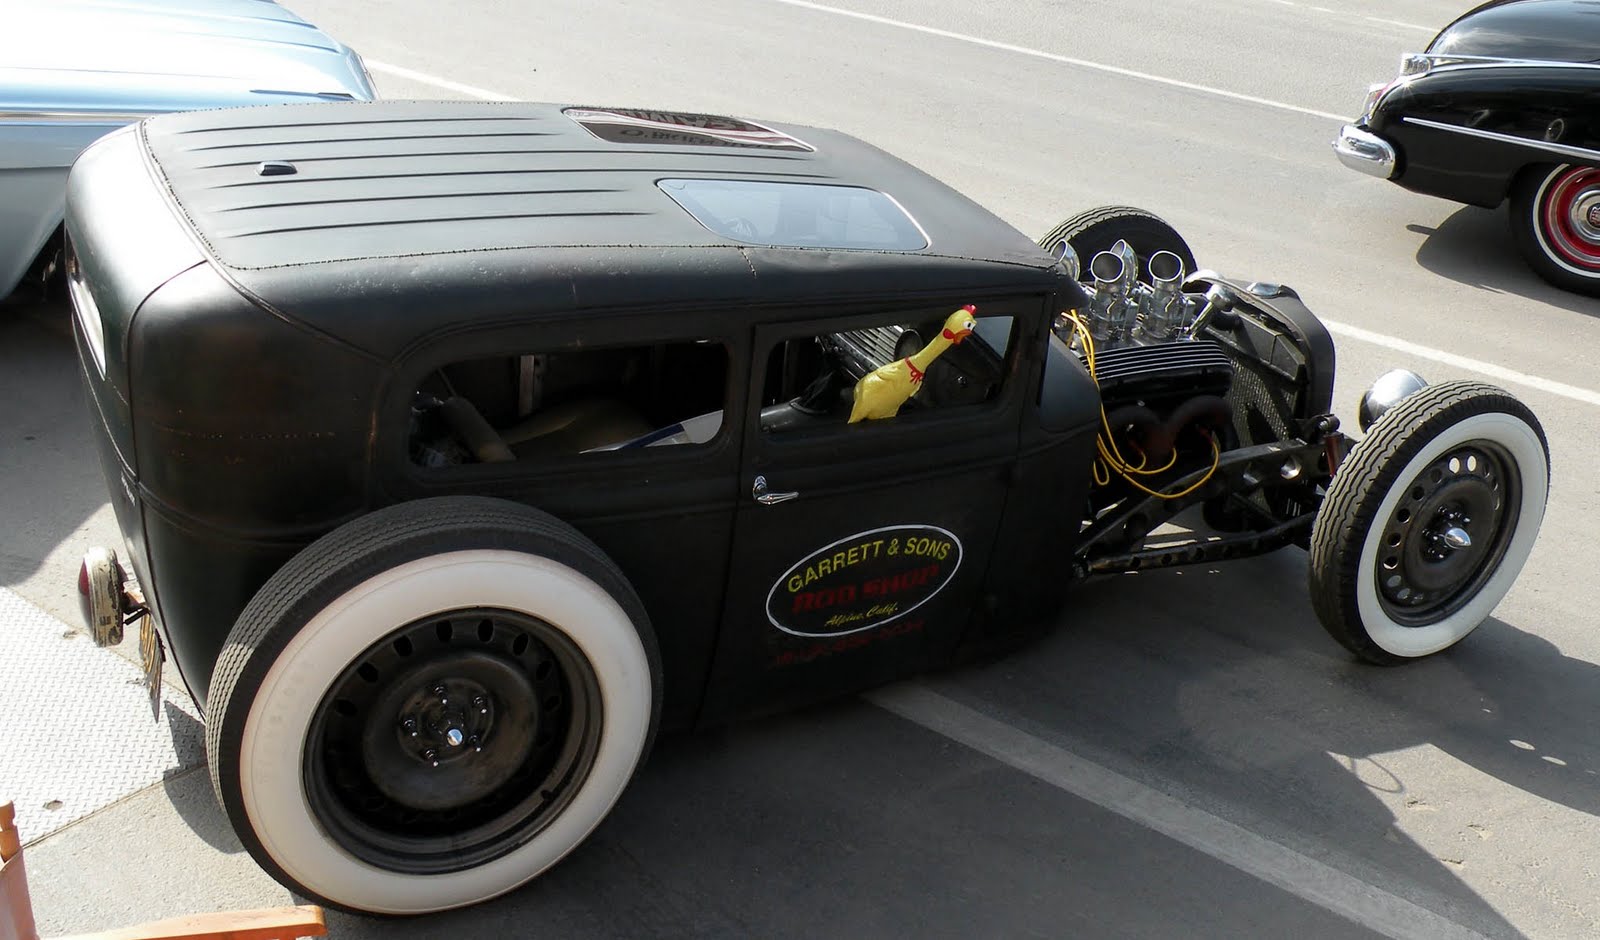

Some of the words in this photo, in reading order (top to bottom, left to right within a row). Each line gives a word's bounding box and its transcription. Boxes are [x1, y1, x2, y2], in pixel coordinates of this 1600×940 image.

[787, 540, 884, 593] GARRETT
[887, 538, 900, 556] &
[904, 537, 952, 560] SONS
[792, 584, 856, 614] ROD
[861, 564, 940, 599] SHOP
